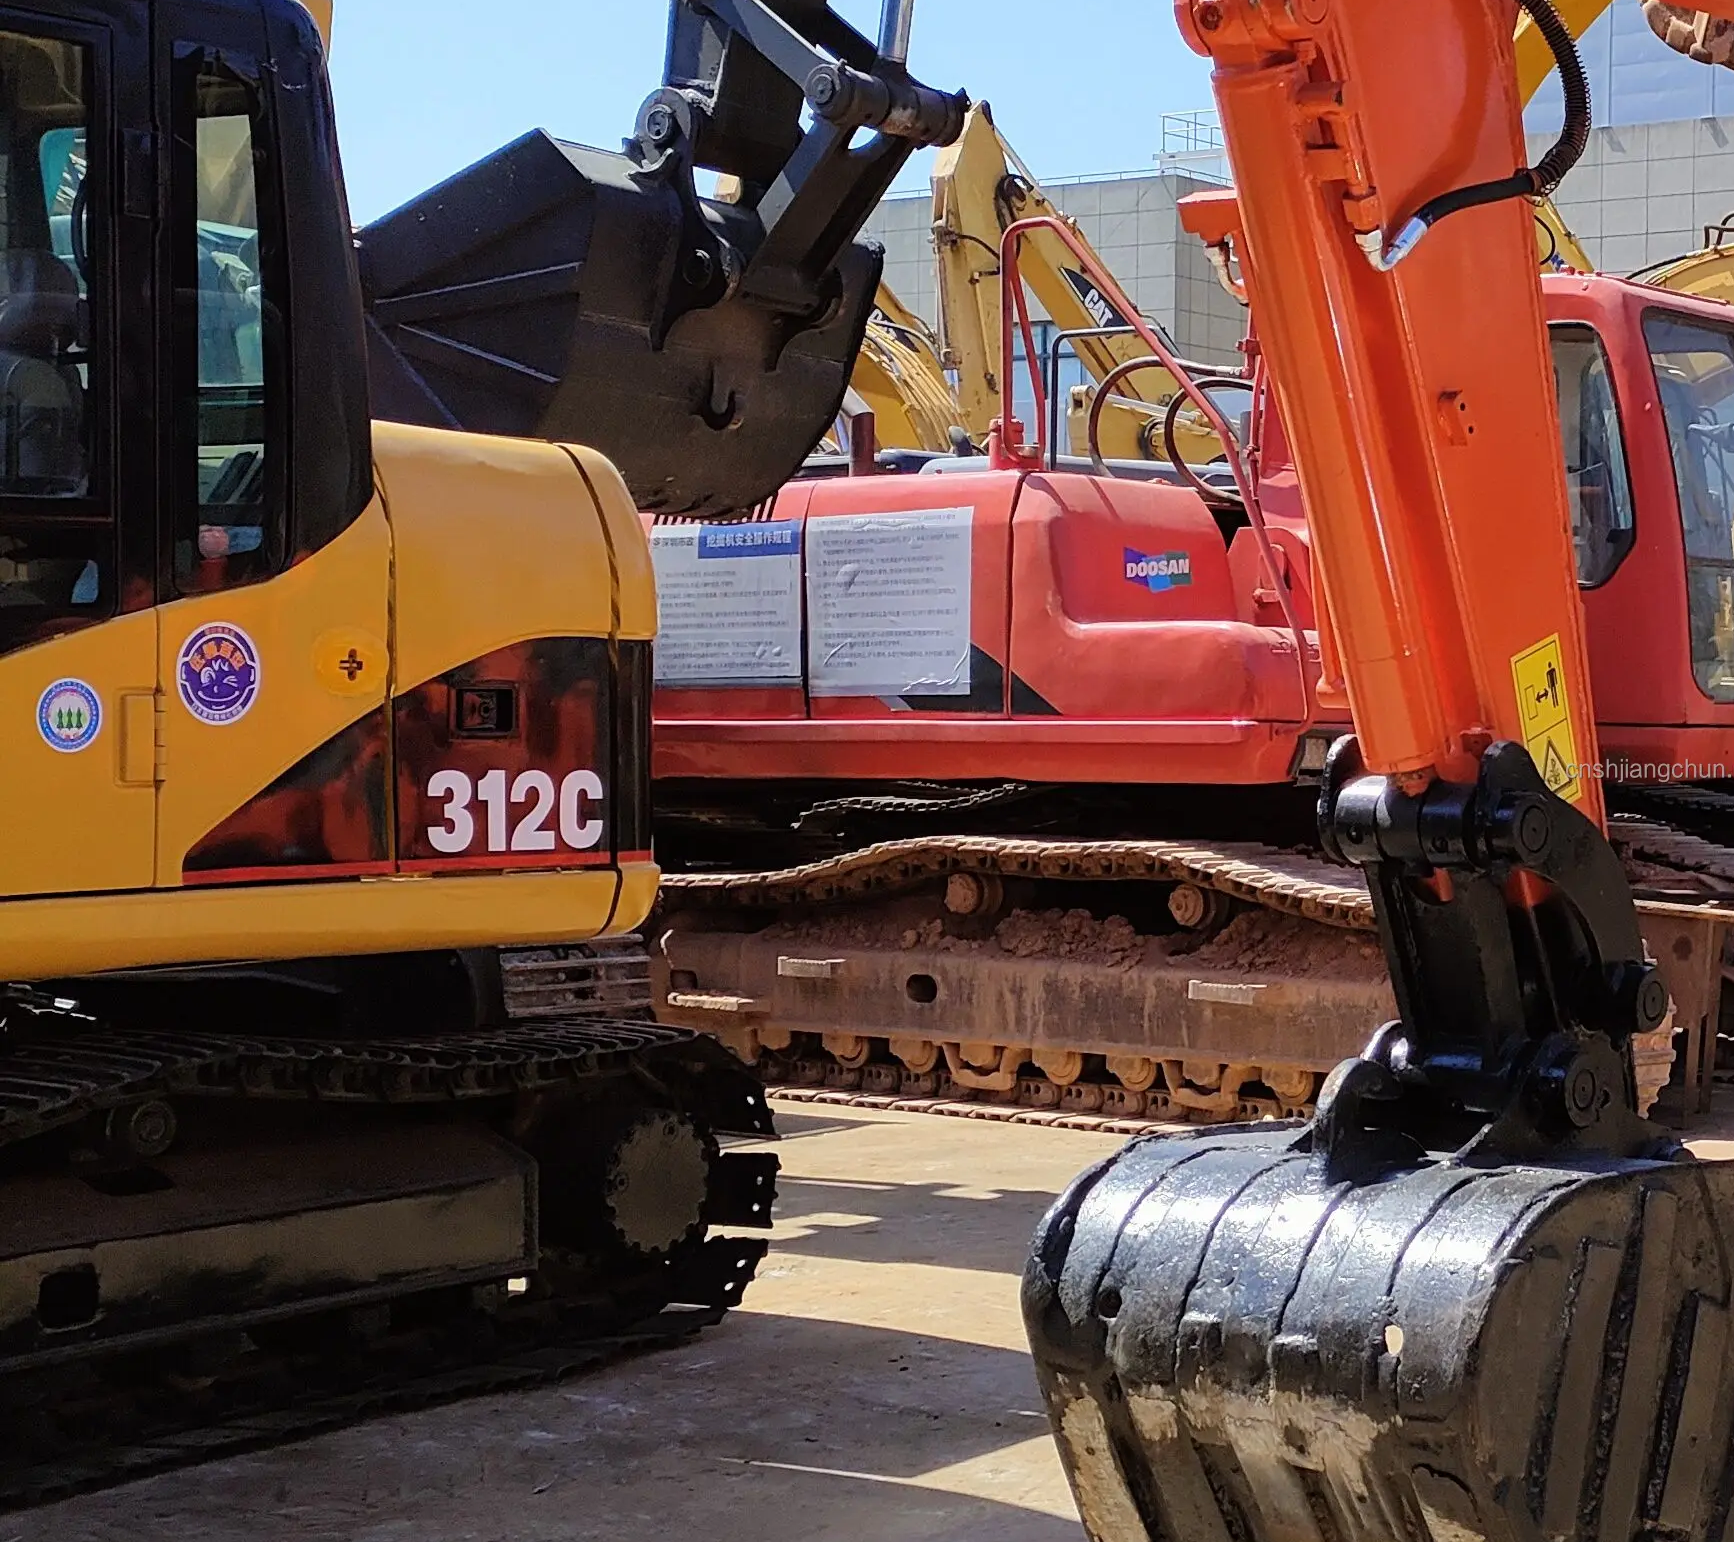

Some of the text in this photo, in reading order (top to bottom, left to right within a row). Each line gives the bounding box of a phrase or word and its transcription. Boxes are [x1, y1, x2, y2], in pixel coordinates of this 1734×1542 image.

[1084, 288, 1113, 327] CAT
[1126, 558, 1190, 578] DOOSAN
[427, 769, 604, 853] 312C
